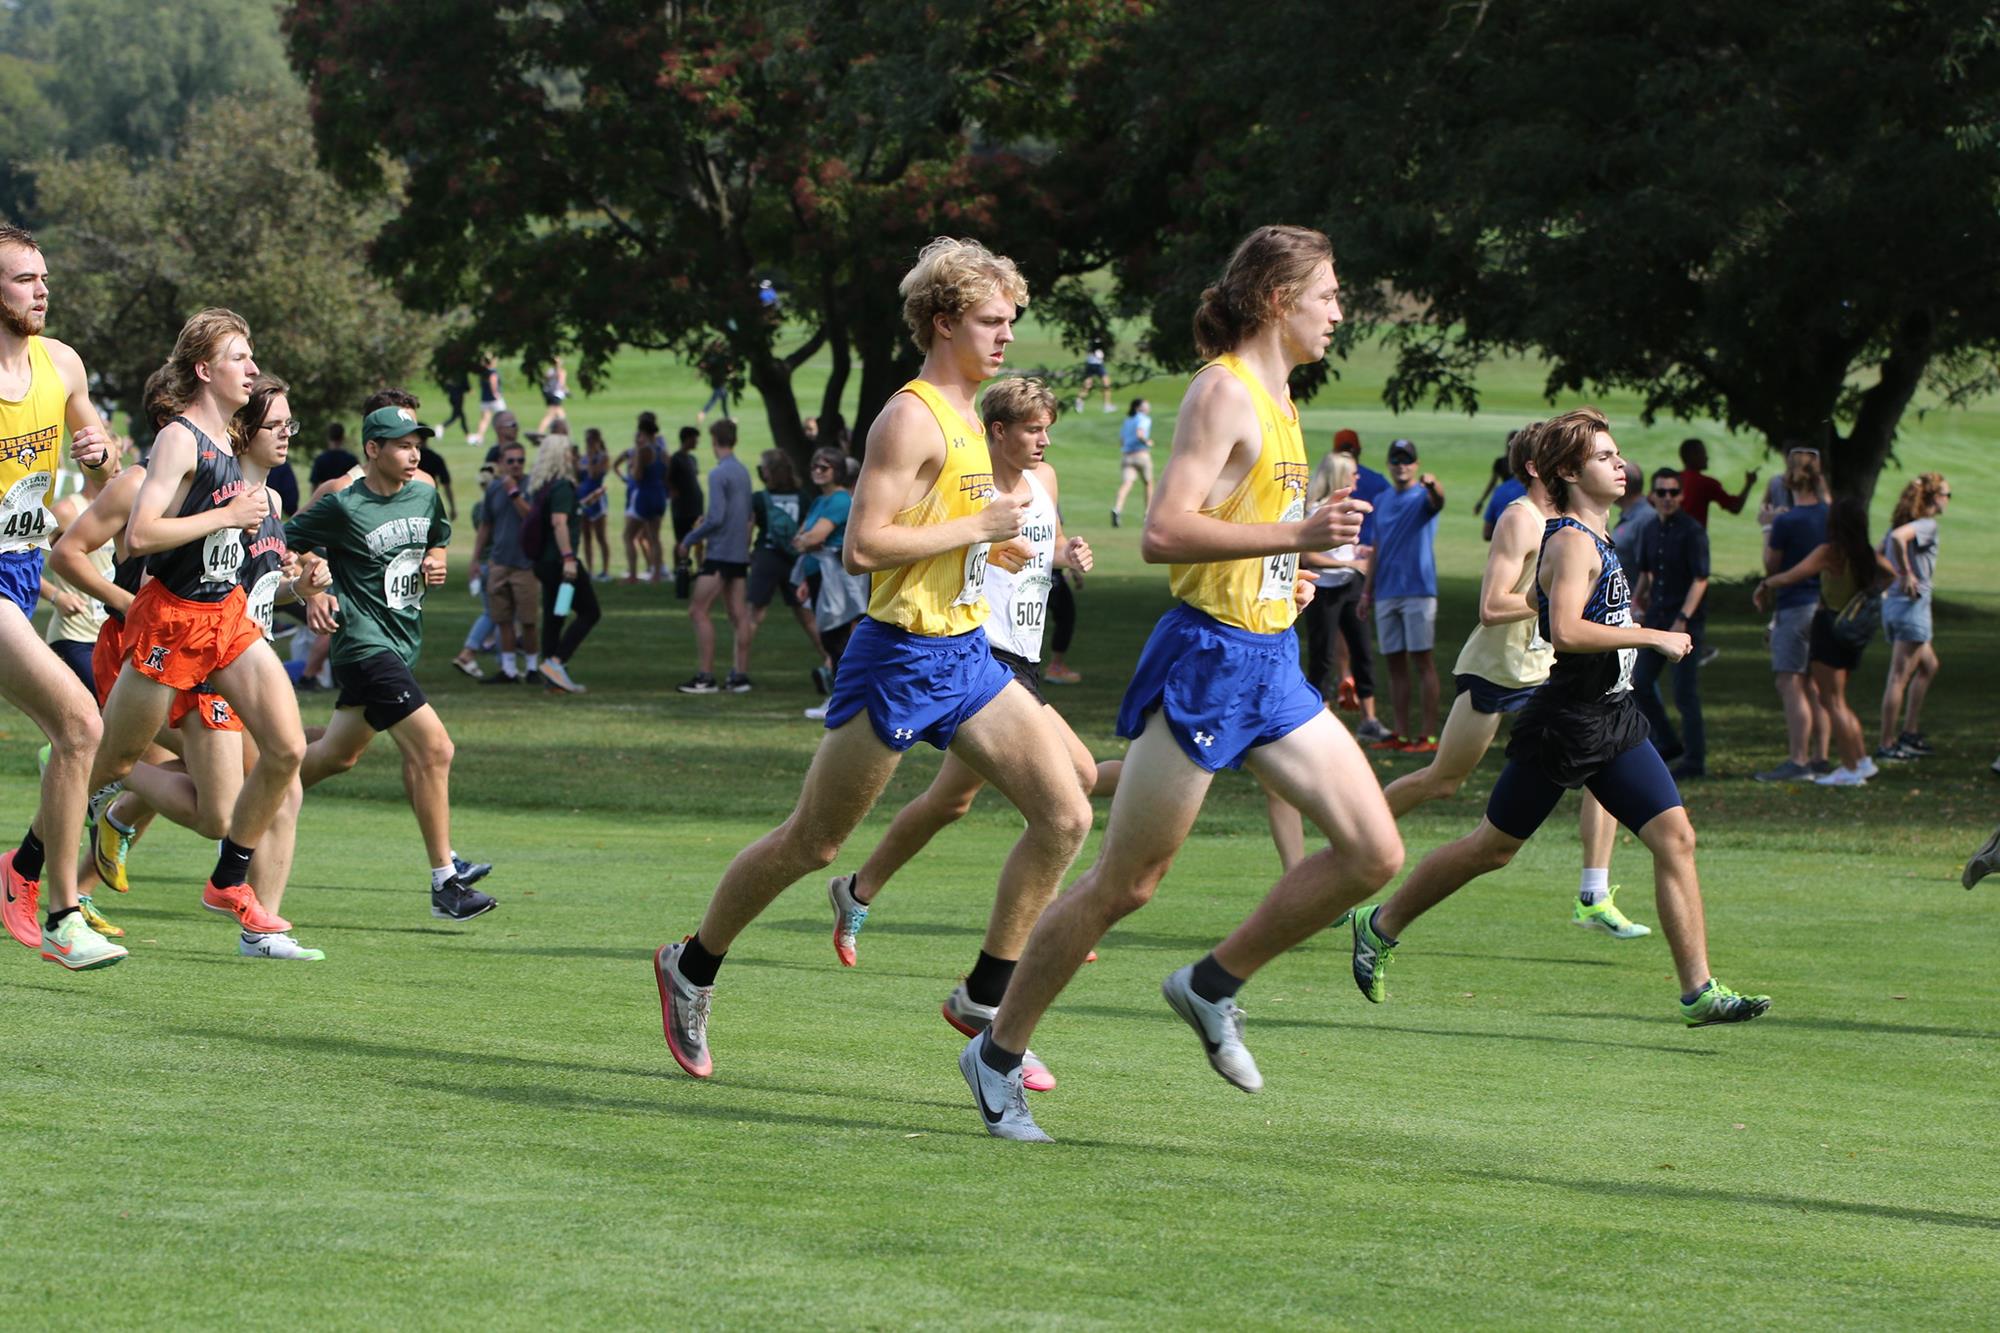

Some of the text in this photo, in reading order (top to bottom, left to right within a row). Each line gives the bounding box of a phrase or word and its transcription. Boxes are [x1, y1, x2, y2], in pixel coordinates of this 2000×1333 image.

[4, 508, 45, 537] 494
[209, 543, 238, 571] 448
[391, 573, 419, 597] 496
[1017, 602, 1043, 626] 502
